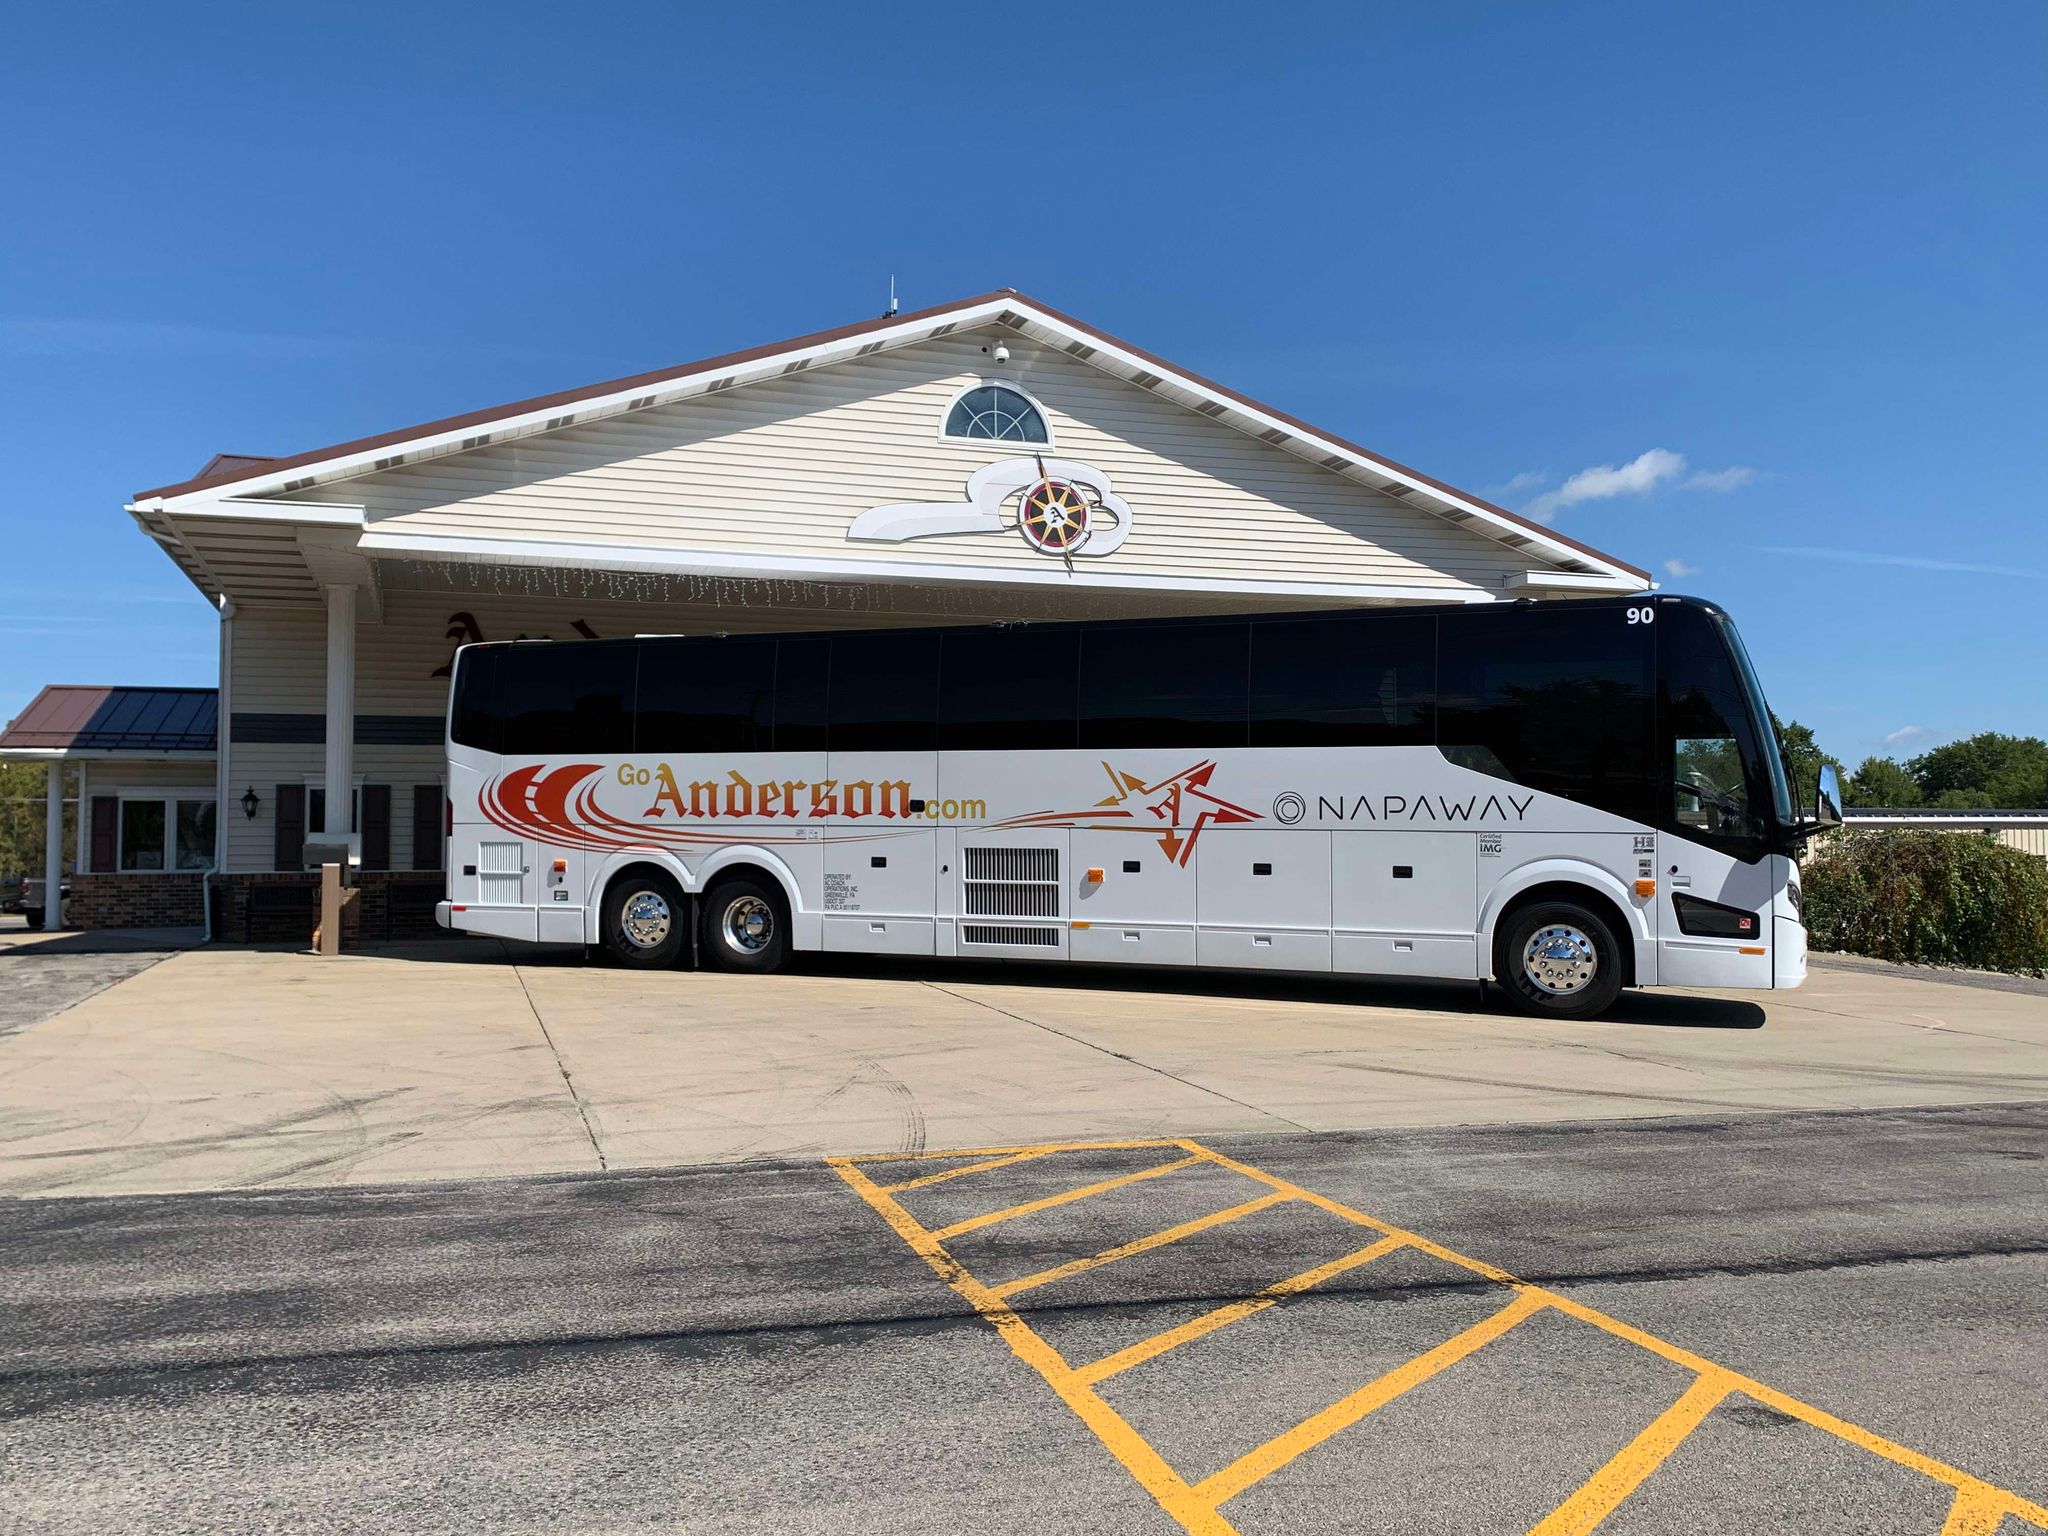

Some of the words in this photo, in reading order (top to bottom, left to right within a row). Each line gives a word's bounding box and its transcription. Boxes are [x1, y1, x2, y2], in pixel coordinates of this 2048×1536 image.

[1626, 607, 1654, 625] 90
[617, 763, 650, 786] Go
[643, 763, 912, 819] Anderson
[1319, 795, 1534, 821] NAPAWAY
[1480, 844, 1502, 853] IMG
